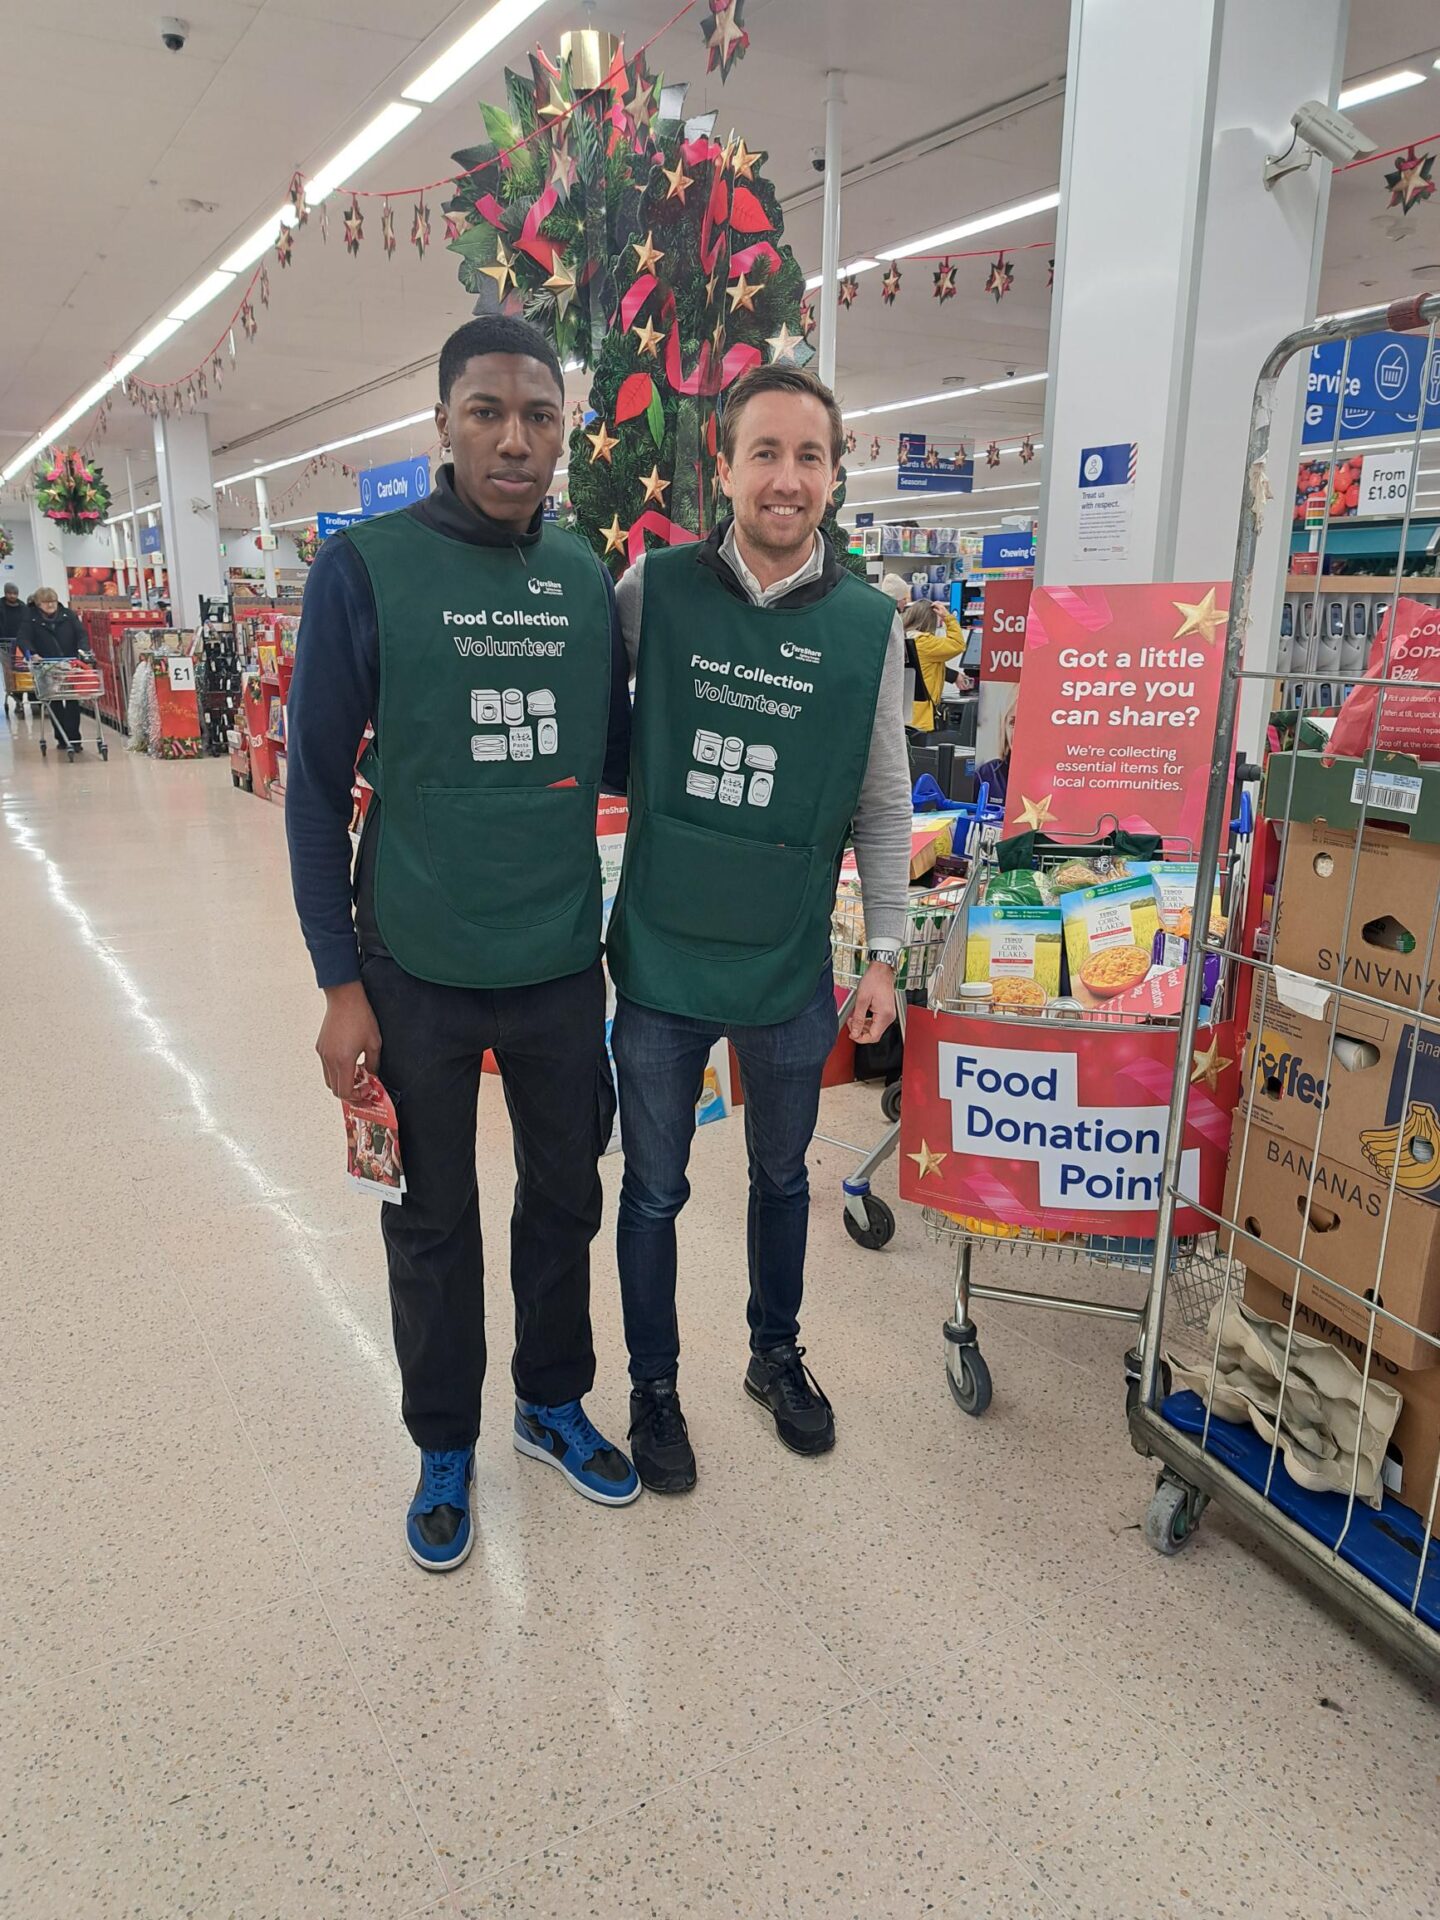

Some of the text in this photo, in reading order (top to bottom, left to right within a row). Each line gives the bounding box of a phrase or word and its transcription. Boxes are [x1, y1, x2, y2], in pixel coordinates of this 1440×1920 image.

[377, 476, 408, 498] Card Only
[1368, 470, 1407, 500] From £1.80
[1081, 502, 1094, 510] with
[1000, 548, 1029, 559] Chewing
[442, 610, 569, 626] Food Collection
[453, 635, 565, 657] Volunteer
[1058, 648, 1205, 668] Got a little
[173, 667, 191, 681] £1
[690, 654, 814, 694] Food Collection
[694, 678, 802, 720] Volunteer
[1061, 680, 1195, 702] spare you
[1051, 706, 1200, 727] can share?
[1066, 744, 1177, 760] We're collecting
[1056, 762, 1184, 775] essential items for
[1053, 776, 1183, 791] local communities.
[1095, 921, 1124, 933] FLAKES
[1098, 916, 1120, 925] CORN
[1318, 948, 1440, 1001] ANANAS
[956, 1056, 1057, 1101] Food
[967, 1105, 1160, 1154] Donation
[1267, 1140, 1382, 1217] BANANAS
